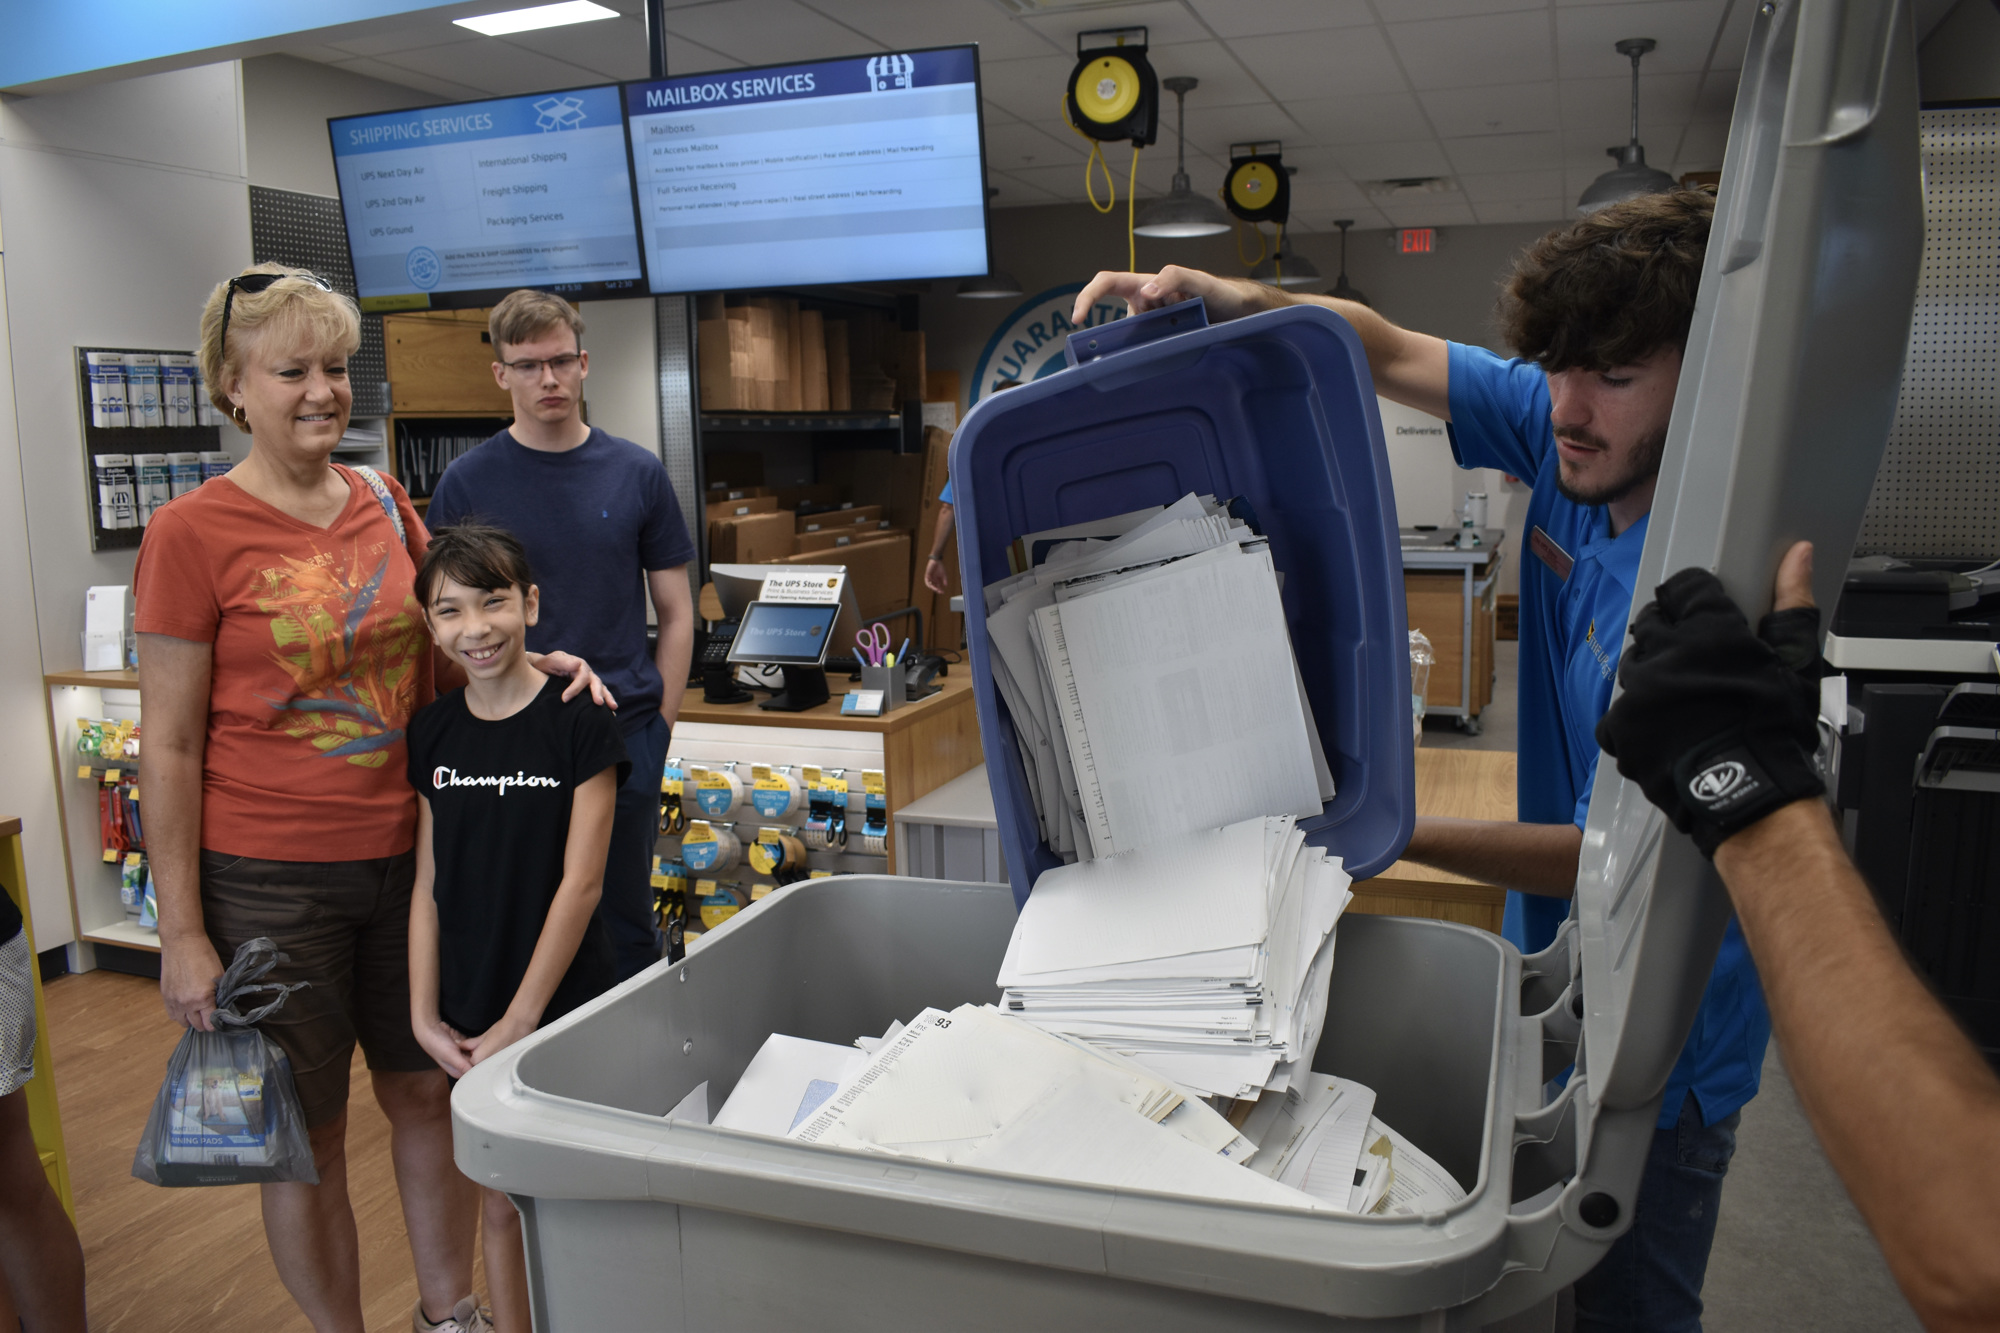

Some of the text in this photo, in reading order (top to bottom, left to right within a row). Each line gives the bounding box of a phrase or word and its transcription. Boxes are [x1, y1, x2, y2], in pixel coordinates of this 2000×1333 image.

[646, 73, 816, 108] MAILBOX SERVICES
[349, 113, 493, 145] SHIPPING SERVICES
[650, 124, 695, 136] Mailboxes
[652, 143, 719, 156] All Access Mailbox
[478, 152, 567, 168] International Shipping
[695, 162, 719, 170] mailbox
[725, 161, 739, 169] copy
[740, 159, 760, 168] printer
[785, 154, 819, 162] notification
[838, 150, 857, 158] street
[858, 148, 882, 156] address
[900, 144, 934, 152] forwarding
[360, 166, 425, 181] UPS Next Day Air
[482, 183, 548, 198] Freight Shipping
[657, 182, 737, 195] Full Service Receiving
[807, 193, 825, 201] street
[827, 191, 850, 199] address
[855, 189, 868, 197] Mail
[868, 187, 902, 196] forwarding
[365, 195, 426, 209] UPS 2nd Day Air
[486, 212, 564, 226] Packaging Services
[369, 225, 414, 238] UPS Ground
[1403, 229, 1432, 252] EXIT
[411, 259, 437, 278] 100%
[618, 280, 633, 288] 2:30
[1396, 426, 1443, 435] Deliveries
[785, 580, 801, 588] UPS
[803, 580, 823, 588] Store
[750, 627, 807, 637] The UPS Store
[433, 766, 560, 796] Champion
[200, 1137, 223, 1145] PADS
